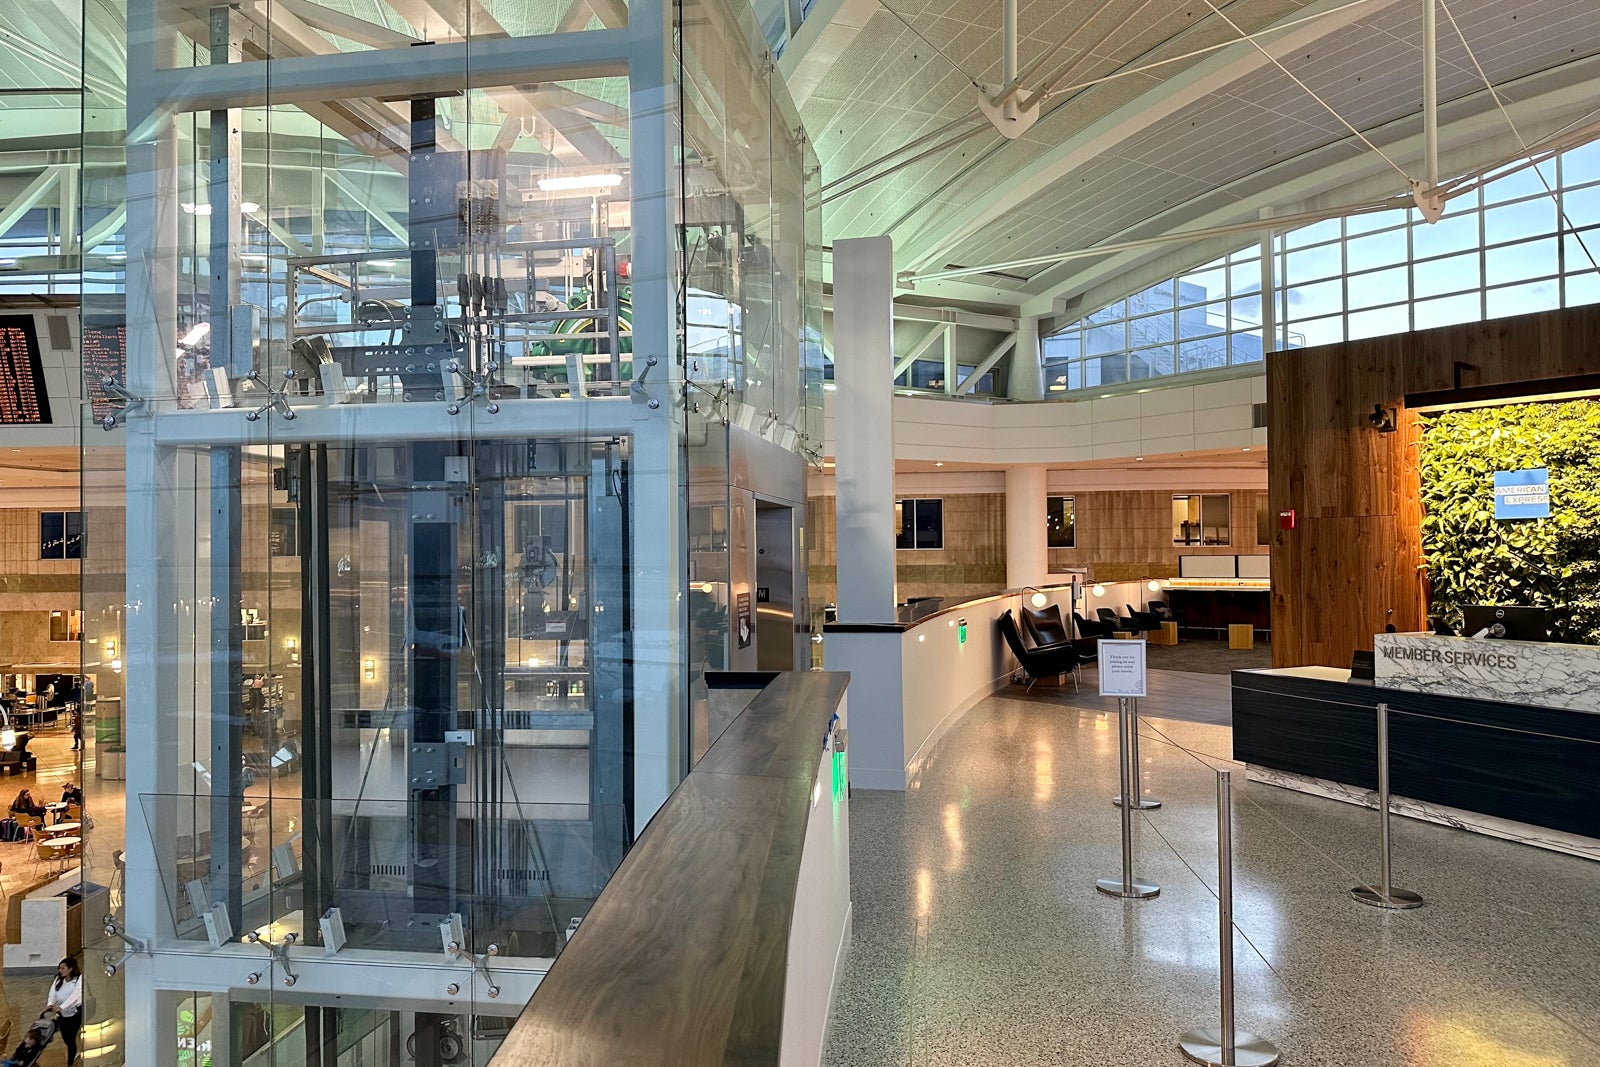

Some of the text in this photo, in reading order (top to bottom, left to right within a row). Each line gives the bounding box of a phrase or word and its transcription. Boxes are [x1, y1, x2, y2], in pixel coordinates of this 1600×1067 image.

[1495, 486, 1544, 494] AMERICAN
[758, 589, 766, 599] M
[1383, 646, 1517, 669] MEMBER SERVICES
